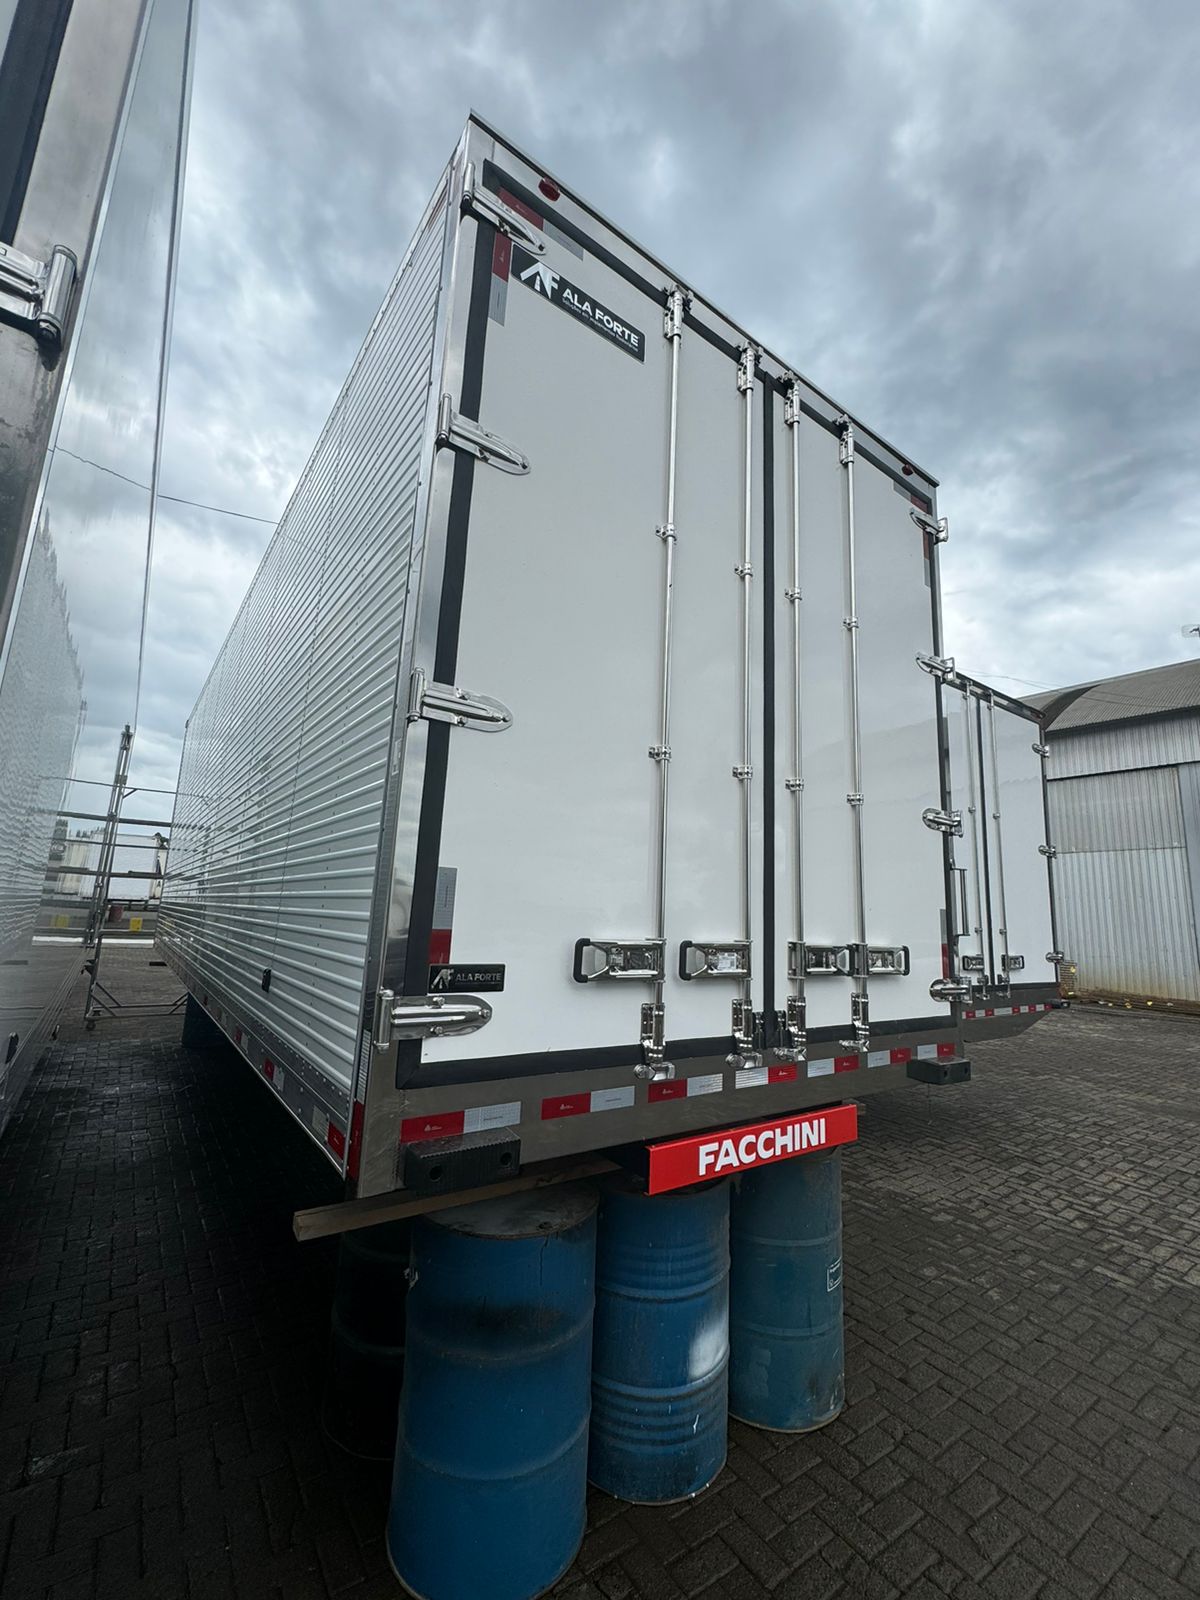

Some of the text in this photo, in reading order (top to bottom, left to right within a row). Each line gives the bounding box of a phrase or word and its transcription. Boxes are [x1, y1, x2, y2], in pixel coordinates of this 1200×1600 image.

[562, 288, 593, 316] ALA
[595, 308, 639, 347] FORTE
[455, 973, 473, 982] ALA
[474, 973, 502, 981] FORTE
[699, 1118, 826, 1176] FACCHINI
